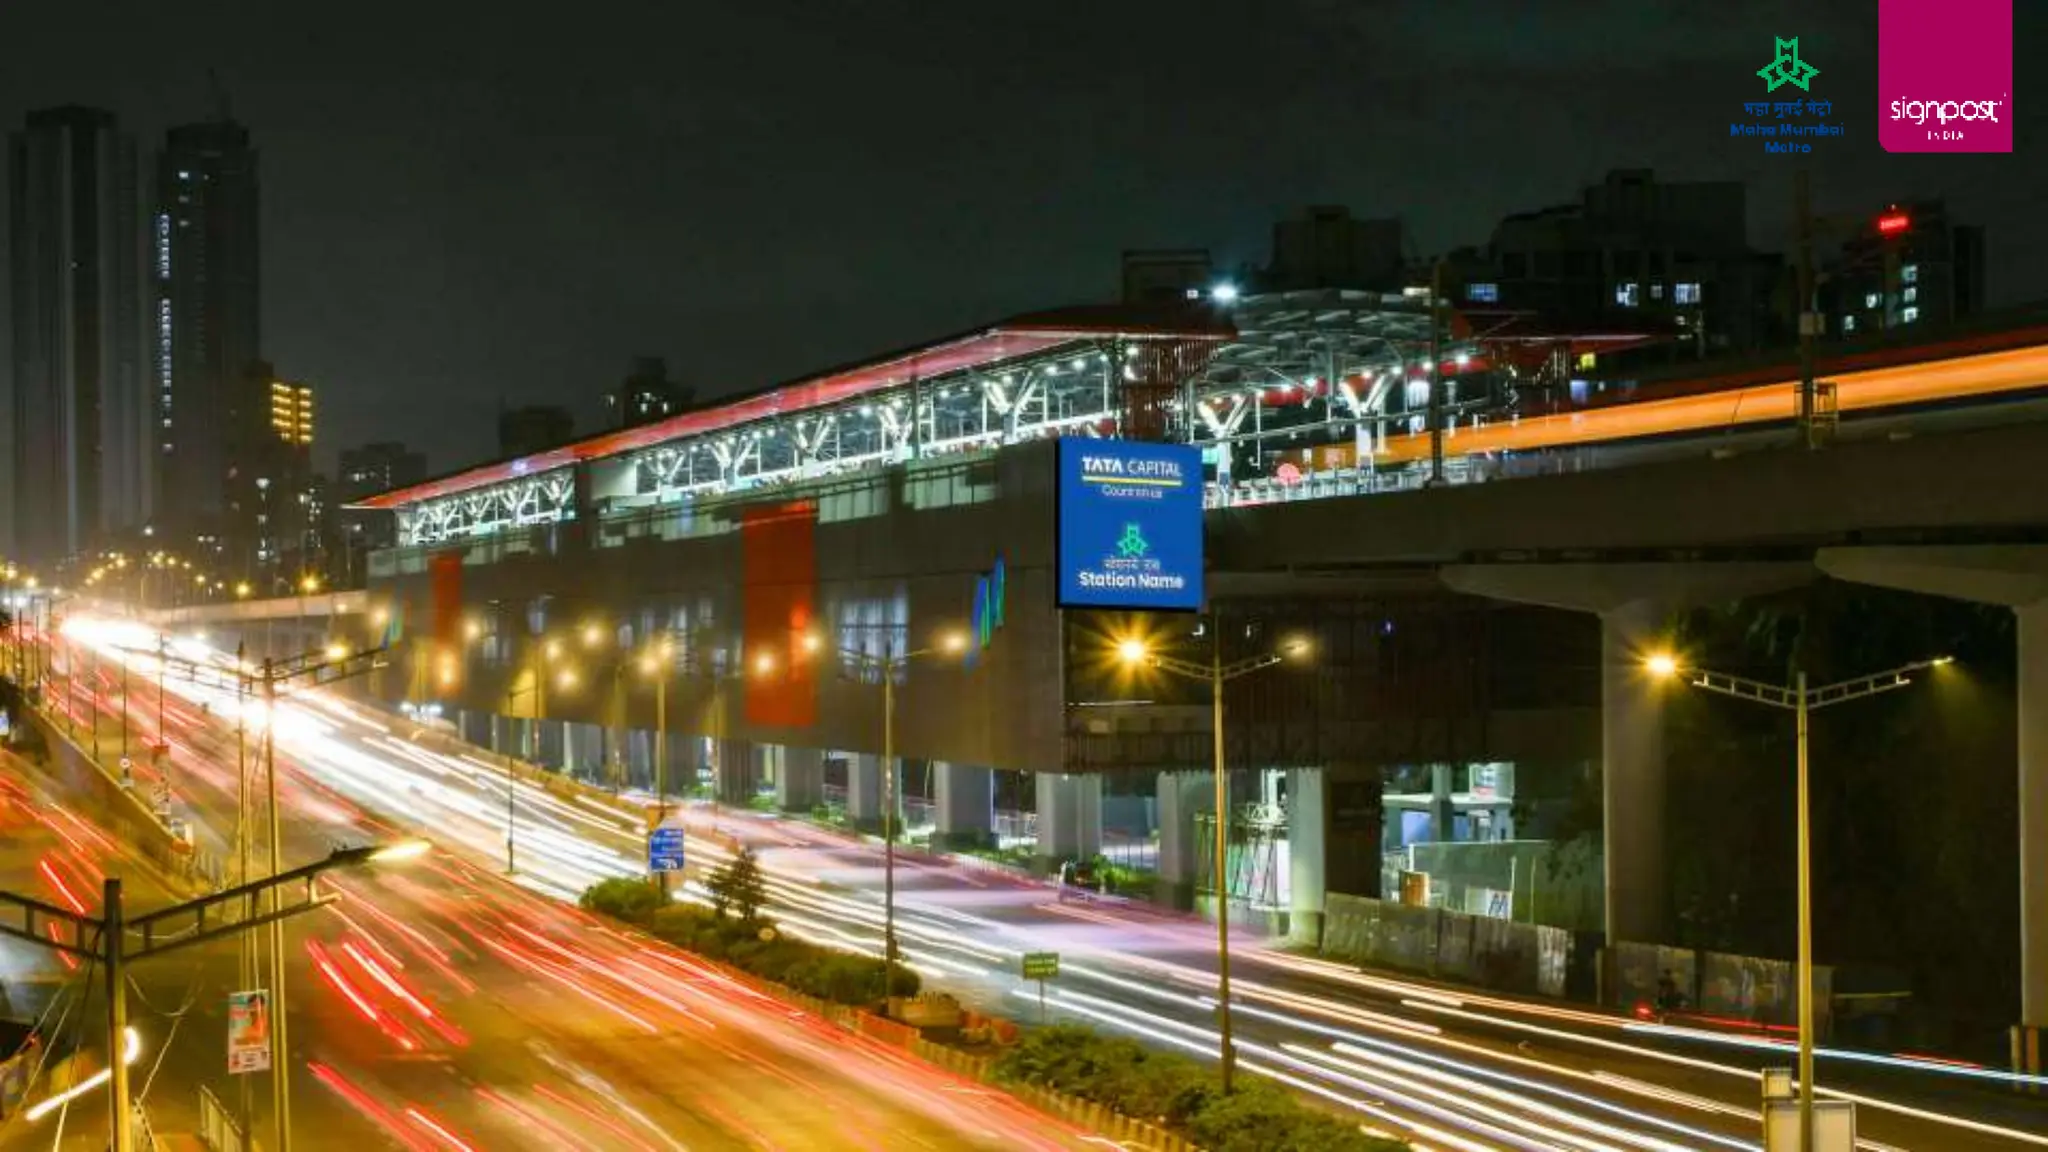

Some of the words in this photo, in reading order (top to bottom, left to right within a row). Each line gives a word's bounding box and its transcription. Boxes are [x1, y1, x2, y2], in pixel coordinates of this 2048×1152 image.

[1082, 456, 1123, 473] TATA
[1127, 460, 1183, 477] CAPITAL
[1080, 571, 1136, 588] Station
[1138, 573, 1185, 589] Name
